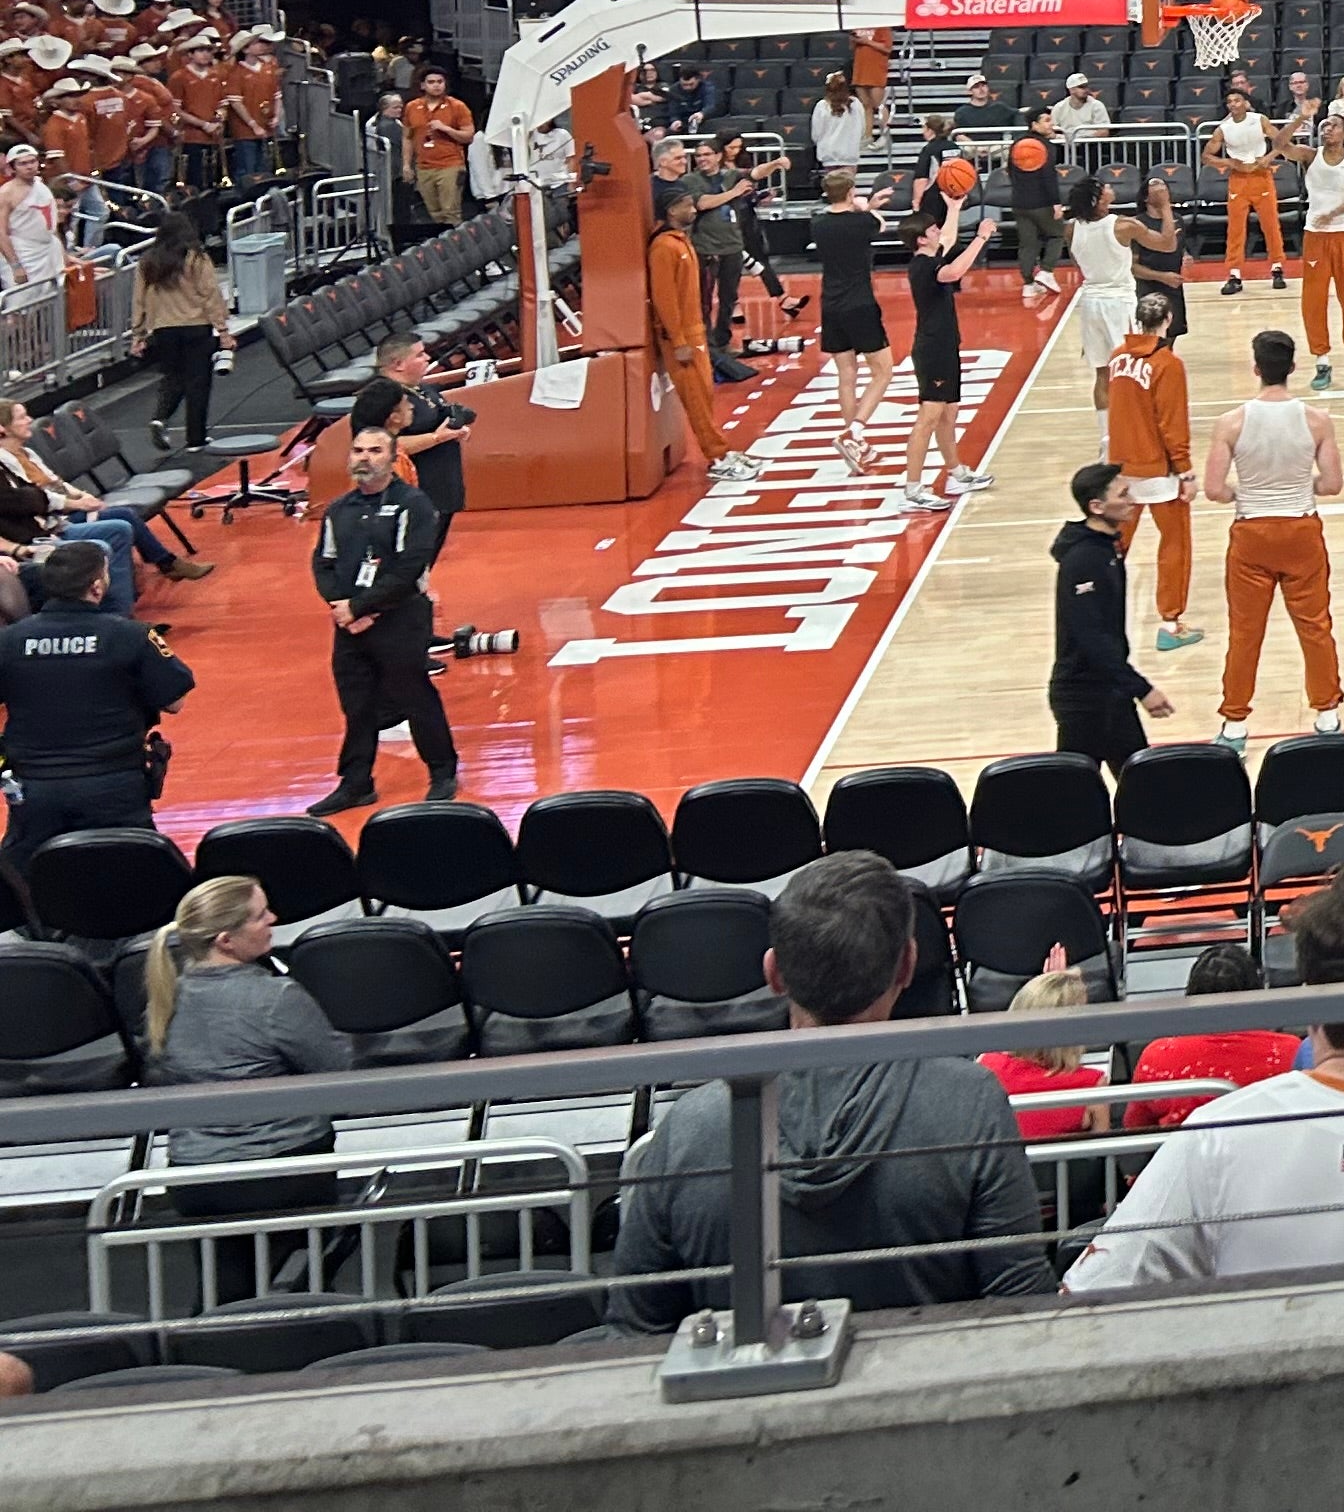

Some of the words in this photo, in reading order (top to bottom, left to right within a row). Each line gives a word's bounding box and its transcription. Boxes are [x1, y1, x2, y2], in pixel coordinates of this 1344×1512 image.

[549, 37, 611, 86] SPALDING
[1108, 353, 1153, 390] TEXAS
[24, 635, 98, 656] POLICE
